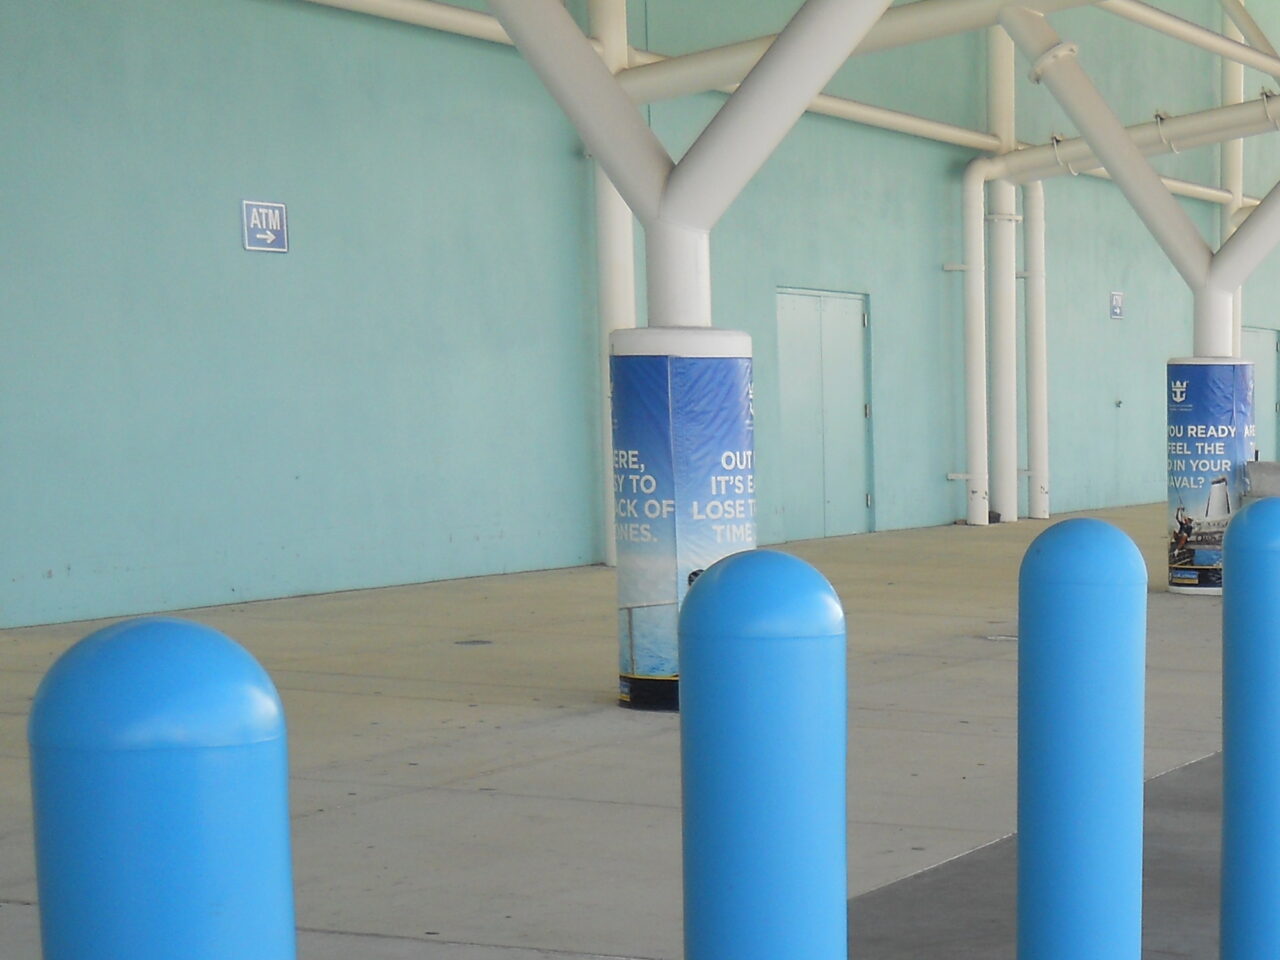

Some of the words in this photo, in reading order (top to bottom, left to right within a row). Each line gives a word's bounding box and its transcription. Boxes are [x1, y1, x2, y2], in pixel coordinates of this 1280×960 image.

[250, 208, 280, 230] ATM
[1187, 425, 1237, 438] READY
[1195, 442, 1225, 455] THE
[721, 450, 752, 471] OUT
[1190, 460, 1231, 472] YOUR
[629, 474, 657, 494] TO
[711, 474, 744, 495] IT'S
[644, 499, 675, 519] OF
[692, 499, 745, 520] LOSE
[711, 523, 753, 543] TIME
